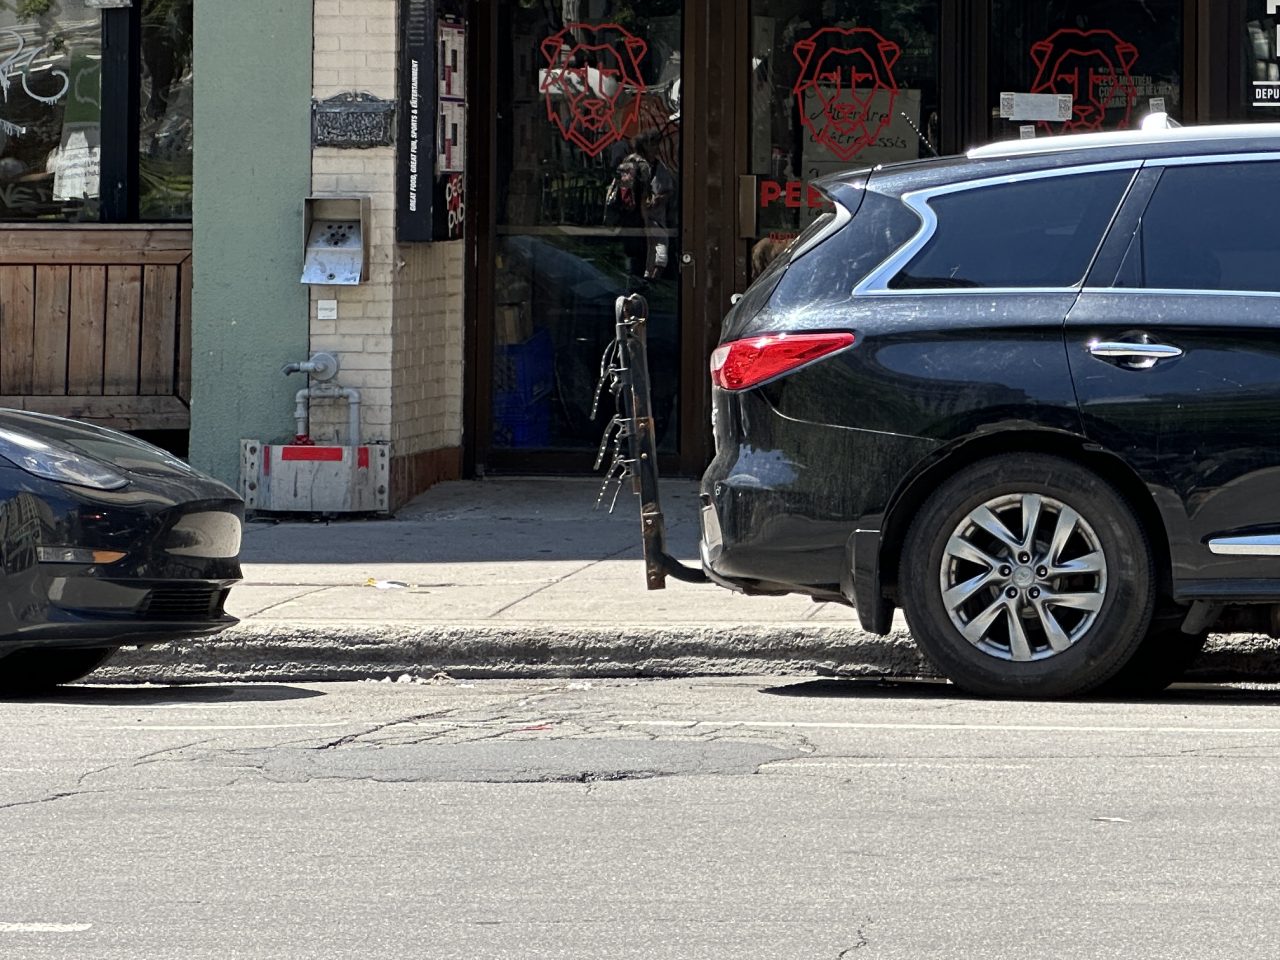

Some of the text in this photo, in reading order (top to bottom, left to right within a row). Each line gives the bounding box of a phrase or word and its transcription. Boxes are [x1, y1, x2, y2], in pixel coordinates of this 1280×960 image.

[410, 59, 419, 108] ENTERTAINMENT
[410, 115, 418, 139] SPORTS
[409, 153, 418, 173] GREAT
[409, 174, 418, 192] FOOD,
[409, 192, 417, 212] GREAT
